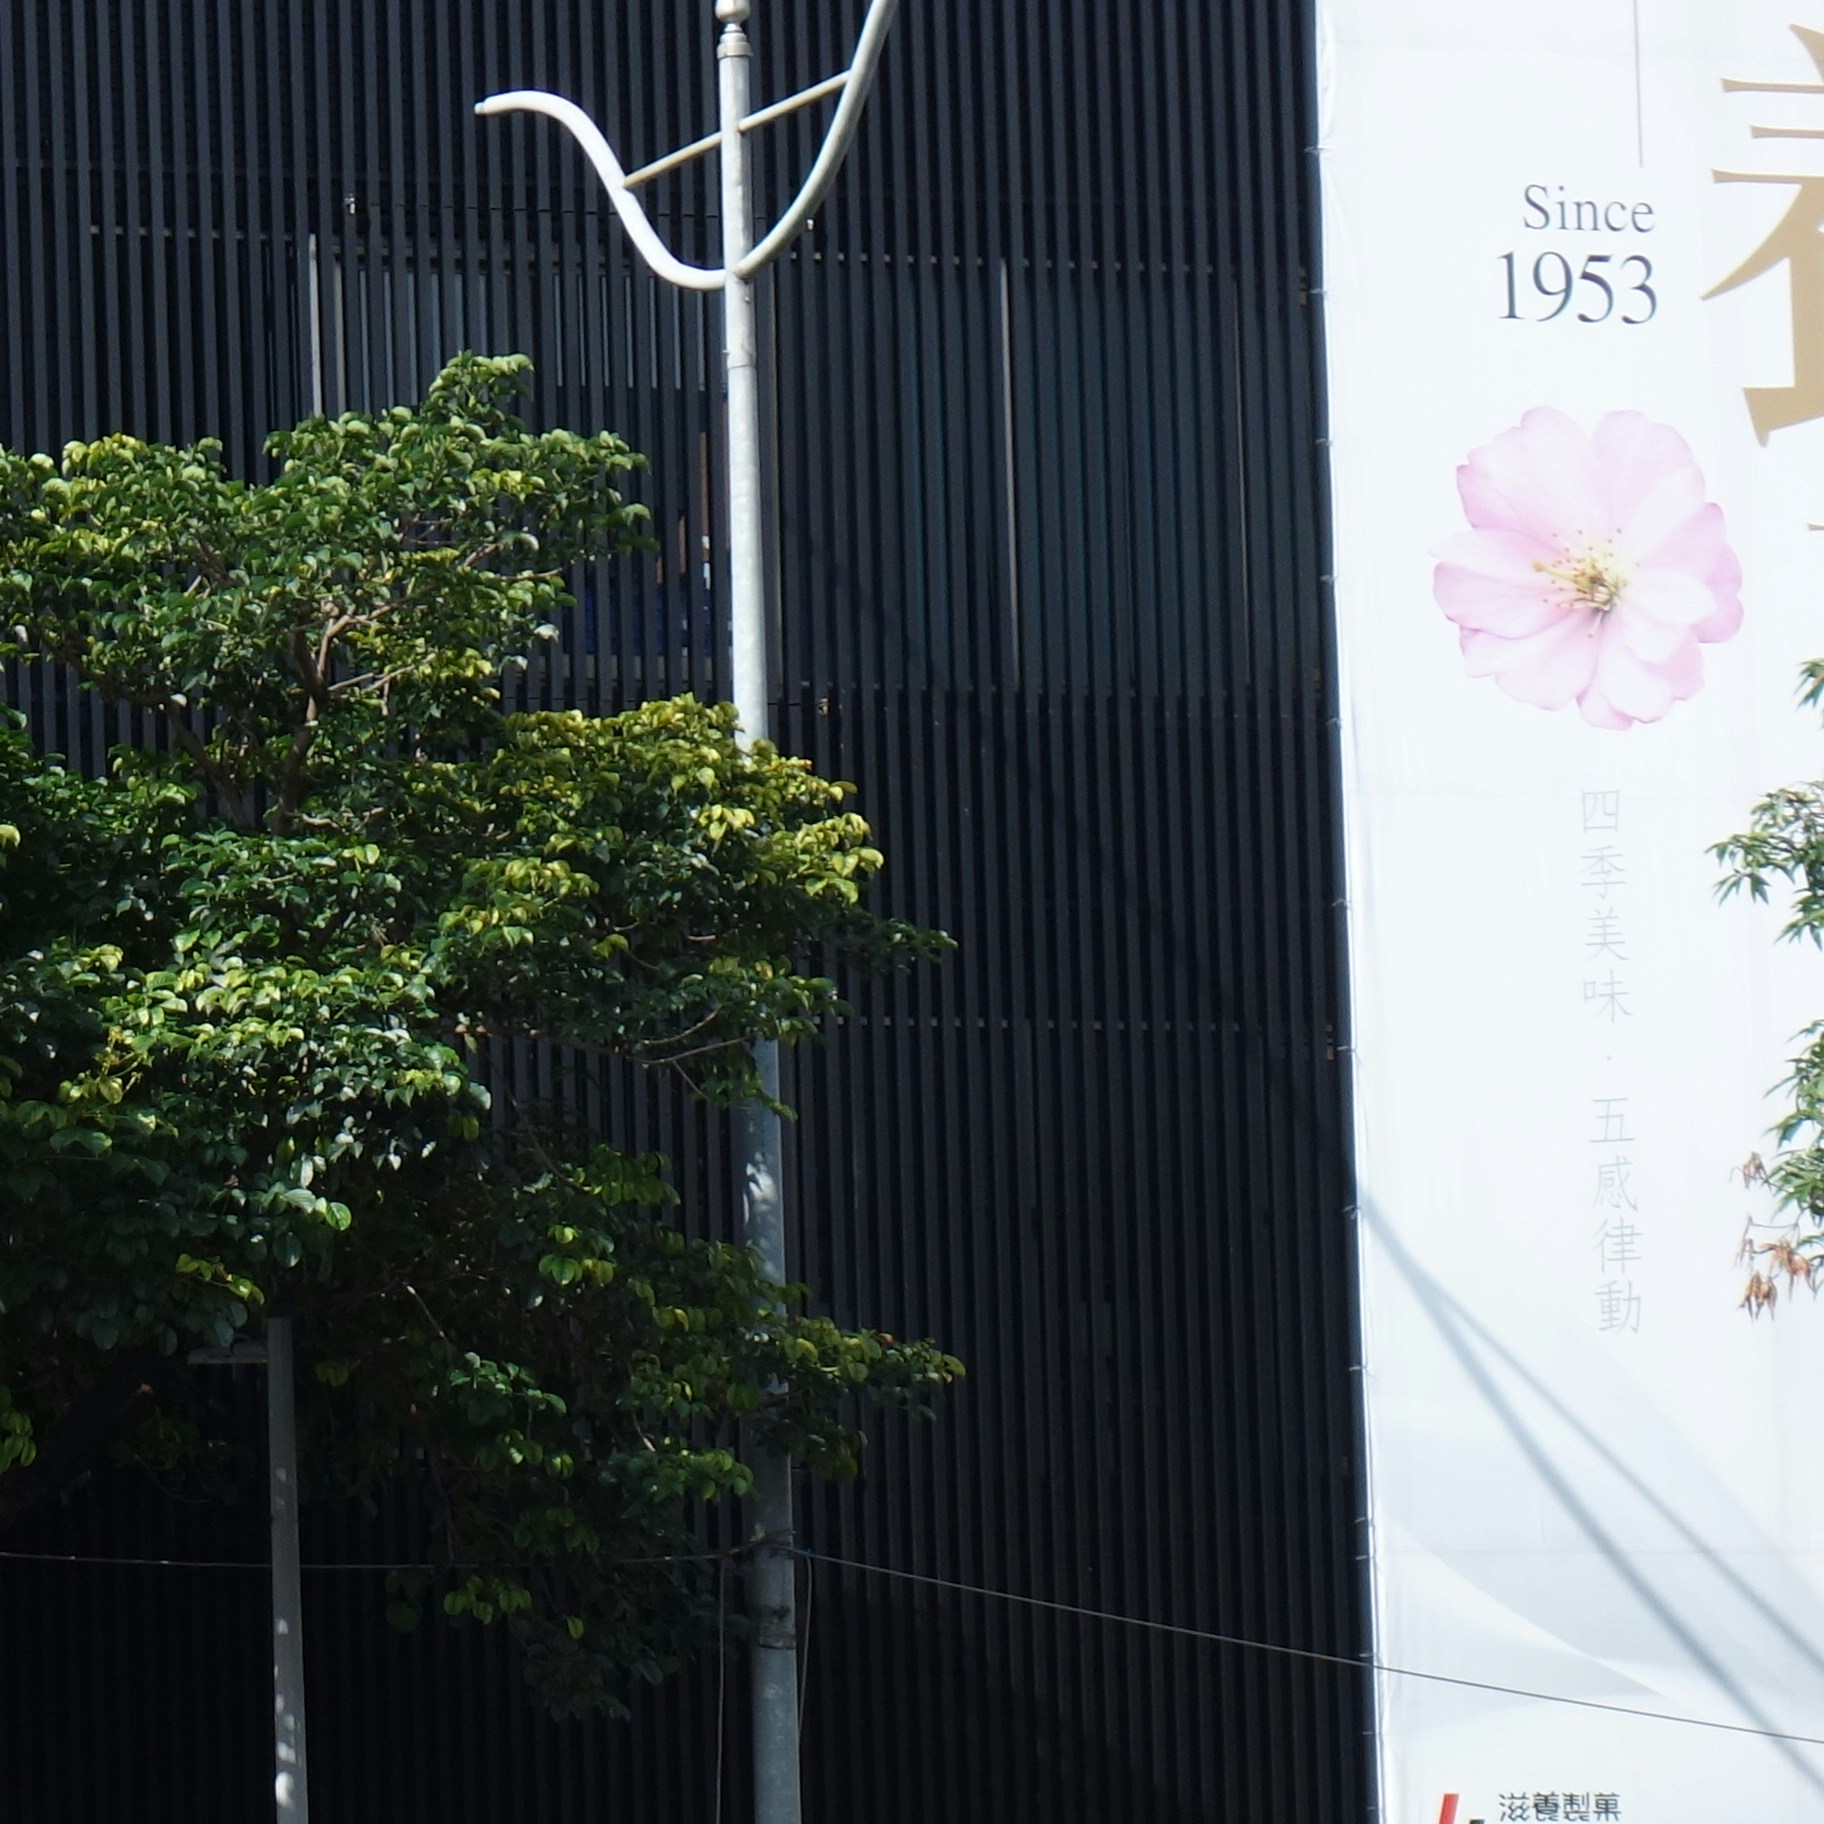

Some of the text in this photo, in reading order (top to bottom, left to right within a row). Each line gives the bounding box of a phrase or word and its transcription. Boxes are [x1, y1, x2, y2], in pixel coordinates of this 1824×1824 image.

[1523, 183, 1656, 233] Since
[1496, 251, 1658, 325] 1953
[1498, 1791, 1622, 1822] 滋養製菓
